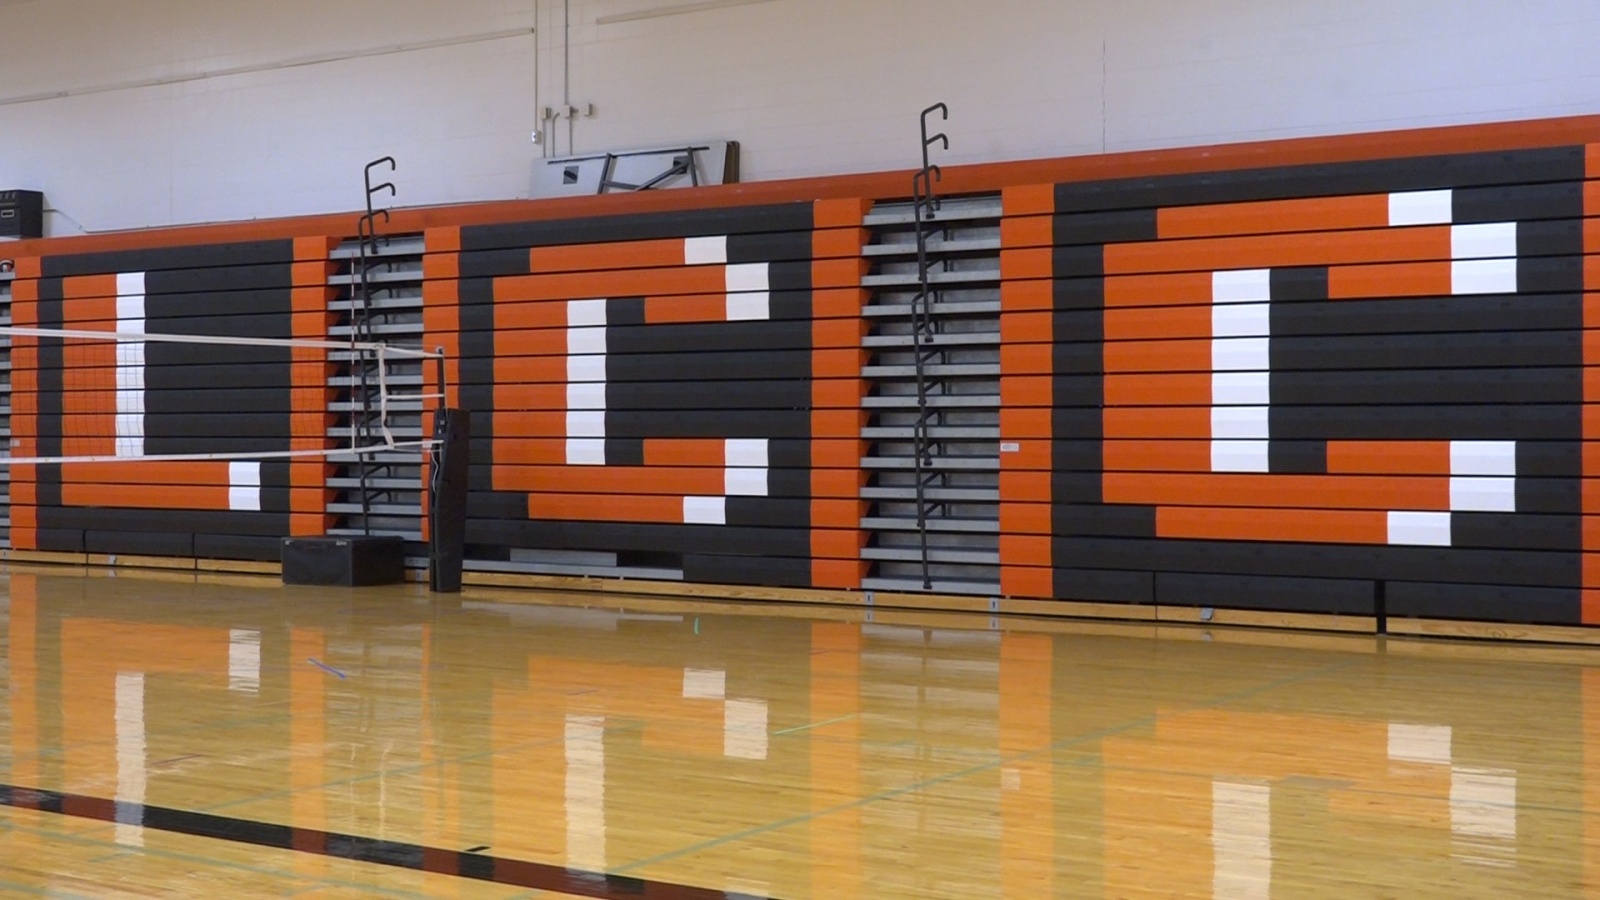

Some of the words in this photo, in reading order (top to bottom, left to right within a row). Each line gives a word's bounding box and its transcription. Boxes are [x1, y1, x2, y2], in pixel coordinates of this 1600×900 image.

[61, 271, 261, 511] L
[491, 235, 769, 525] C
[1102, 190, 1517, 547] C
